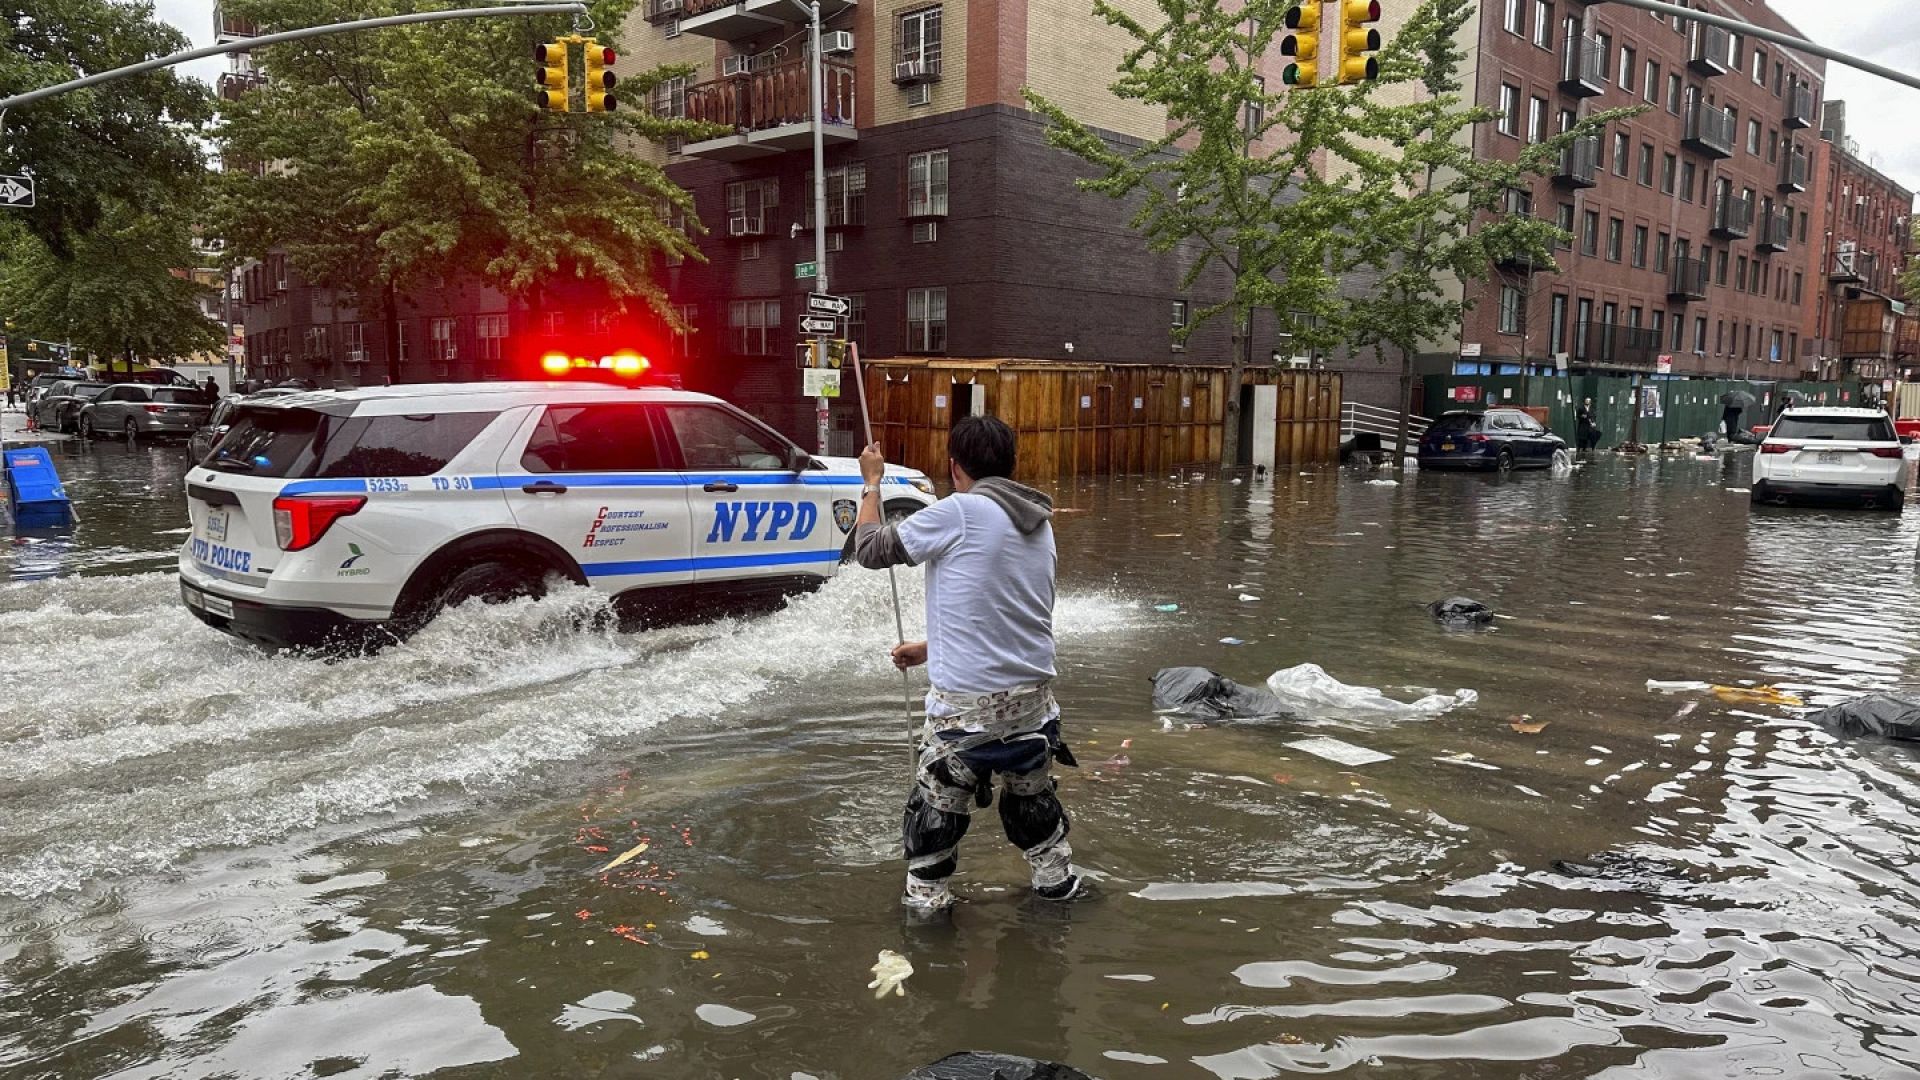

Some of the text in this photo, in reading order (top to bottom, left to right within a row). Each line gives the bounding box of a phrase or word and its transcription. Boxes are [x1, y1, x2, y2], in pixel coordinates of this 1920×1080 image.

[0, 185, 19, 197] AY
[813, 299, 826, 307] ONE
[806, 321, 816, 329] ONE
[432, 476, 469, 490] TD 30
[706, 502, 818, 543] NYPD
[211, 544, 251, 573] POLICE
[337, 568, 370, 577] HYBRID
